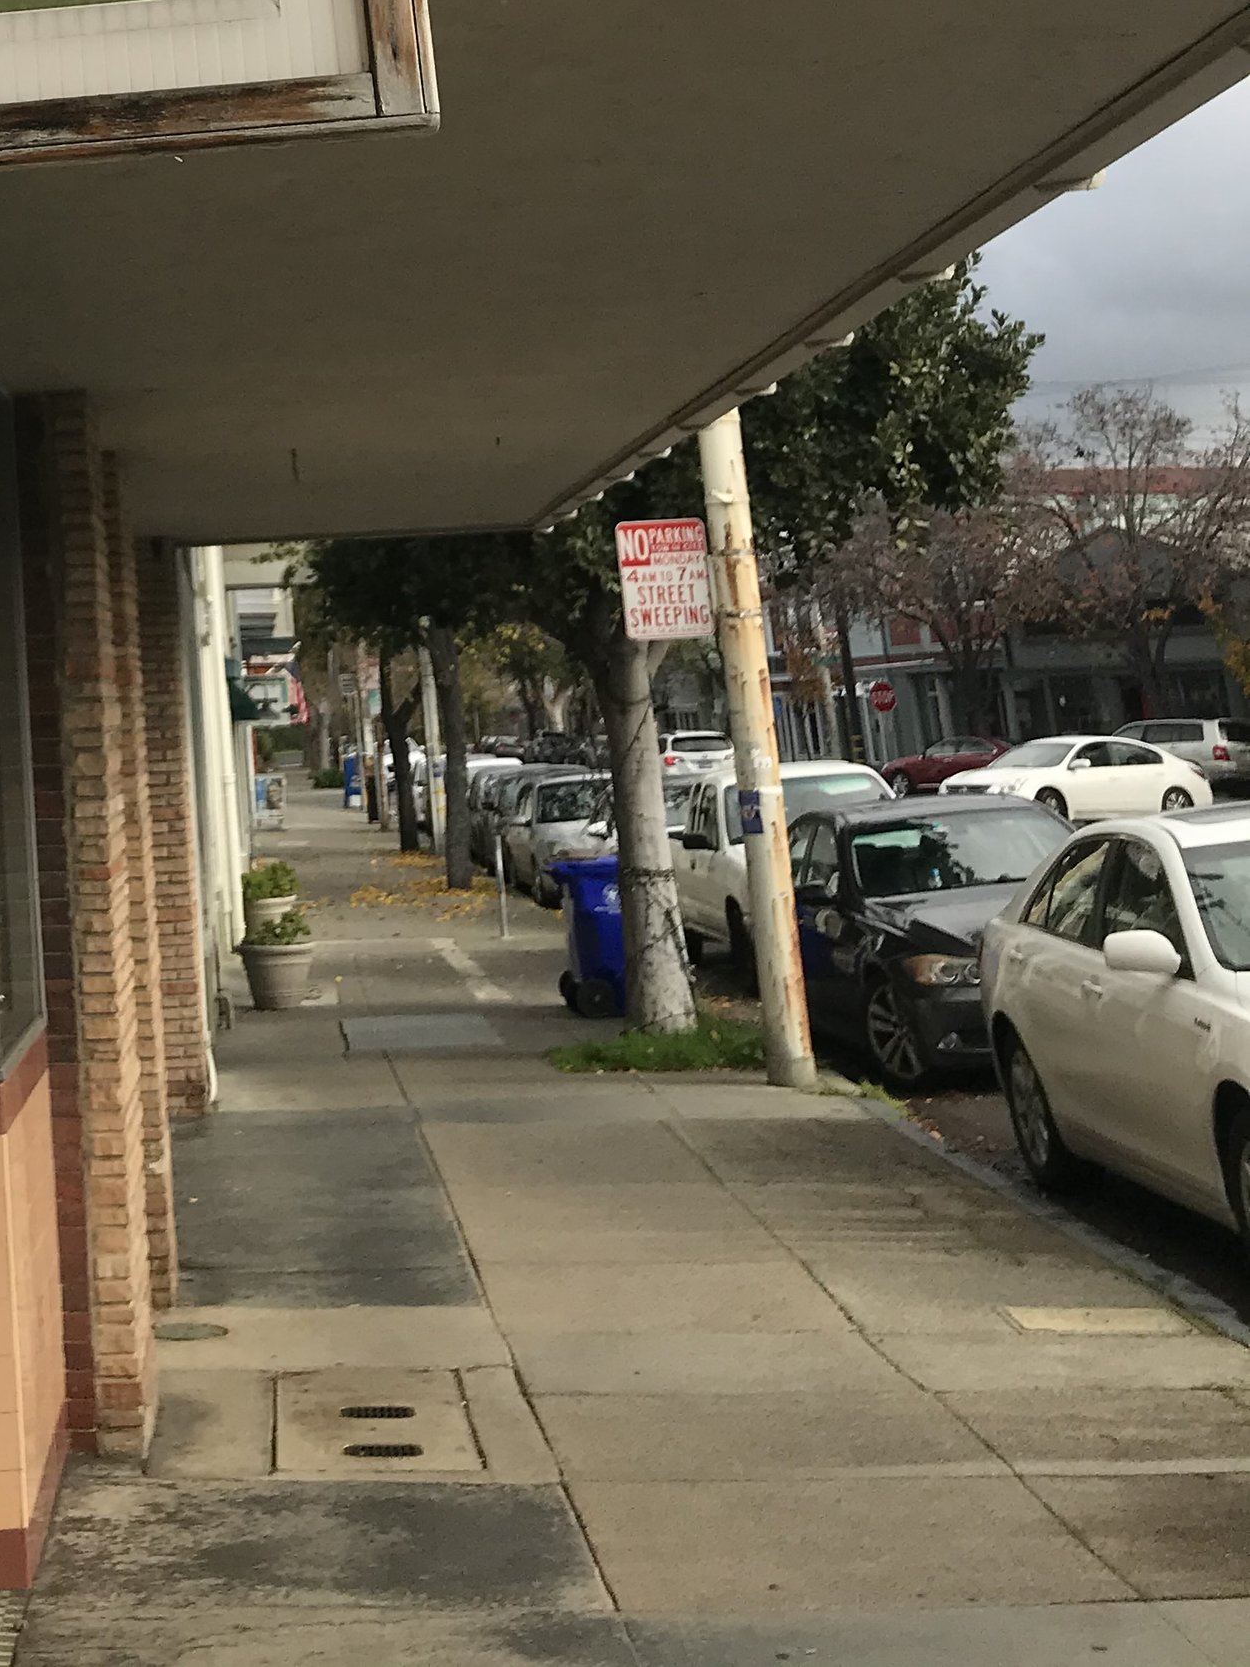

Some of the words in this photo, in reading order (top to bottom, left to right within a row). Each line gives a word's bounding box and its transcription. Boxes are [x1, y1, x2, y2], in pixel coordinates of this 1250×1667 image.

[617, 528, 650, 562] NO
[648, 525, 704, 544] PARKING
[653, 552, 702, 565] MONDAY
[626, 569, 639, 583] 4
[642, 572, 656, 582] AM
[677, 566, 687, 582] 7
[637, 583, 695, 606] STREET
[630, 604, 710, 628] SWEEPING
[871, 689, 895, 704] STOP
